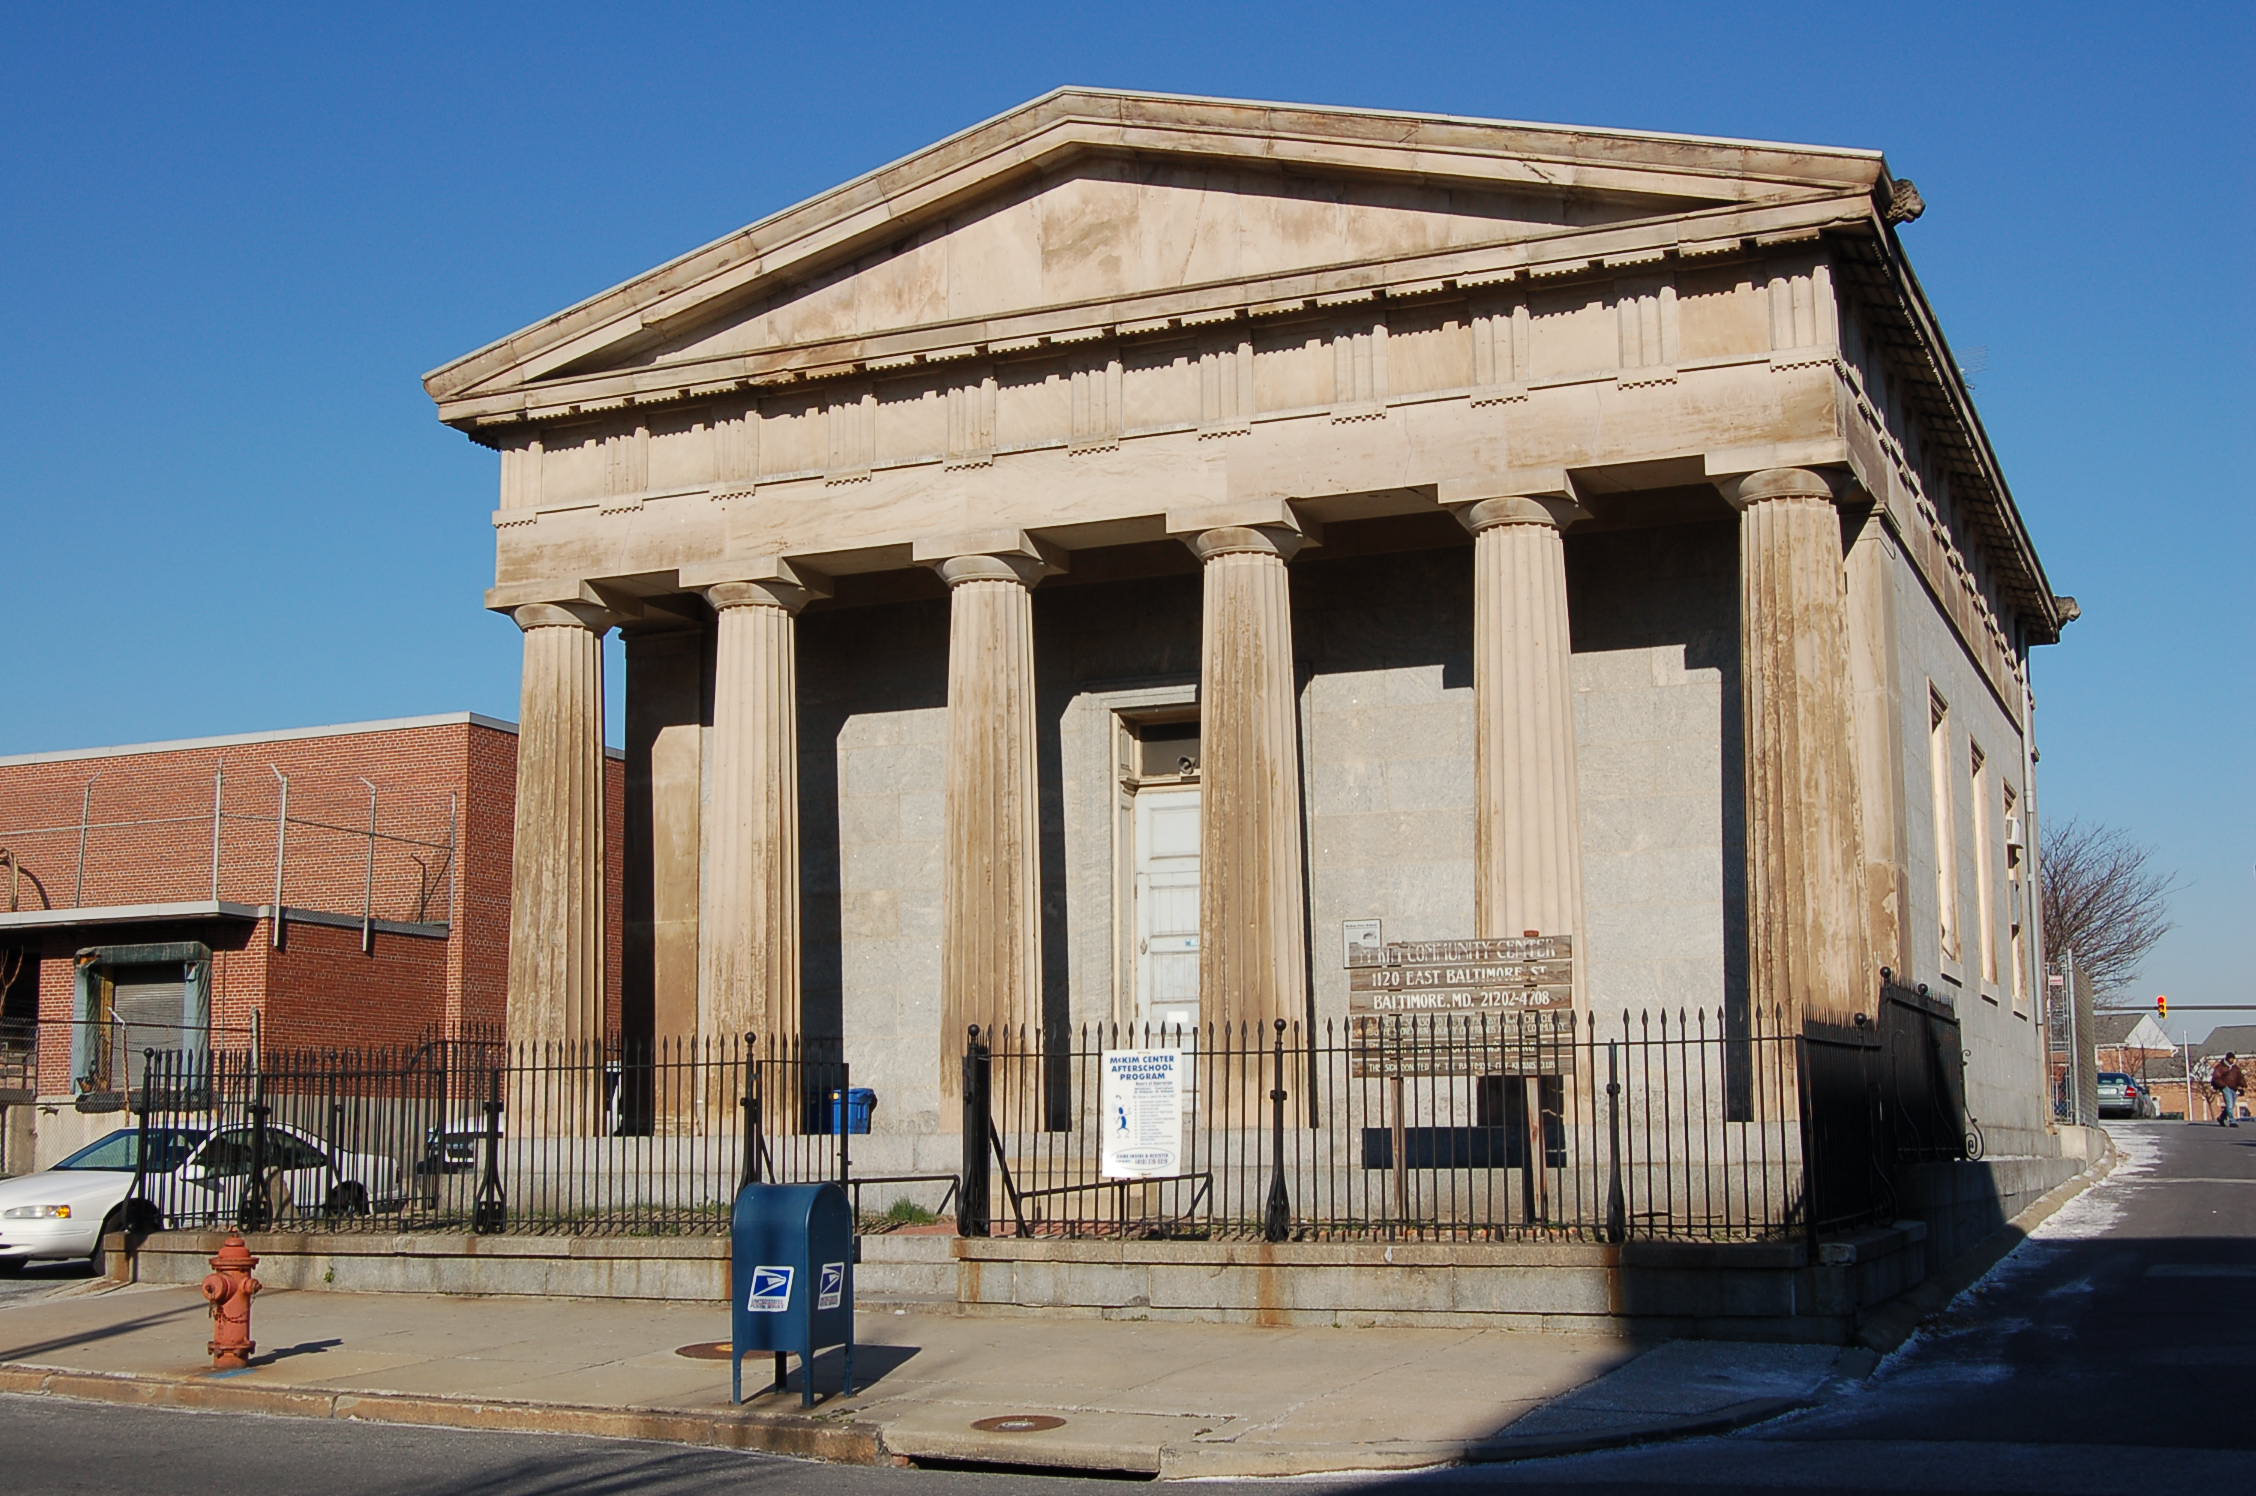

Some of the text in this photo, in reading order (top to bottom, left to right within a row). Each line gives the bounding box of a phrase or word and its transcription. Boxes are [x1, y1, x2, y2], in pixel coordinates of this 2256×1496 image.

[1496, 938, 1556, 959] CENTER
[1372, 971, 1400, 987] 1120
[1406, 969, 1441, 986] EAST
[1446, 966, 1523, 985] BALTIMORE
[1142, 1055, 1175, 1063] CENTER
[1111, 1064, 1174, 1072] AFTERSCHOOL
[1120, 1072, 1165, 1080] PROGRAM
